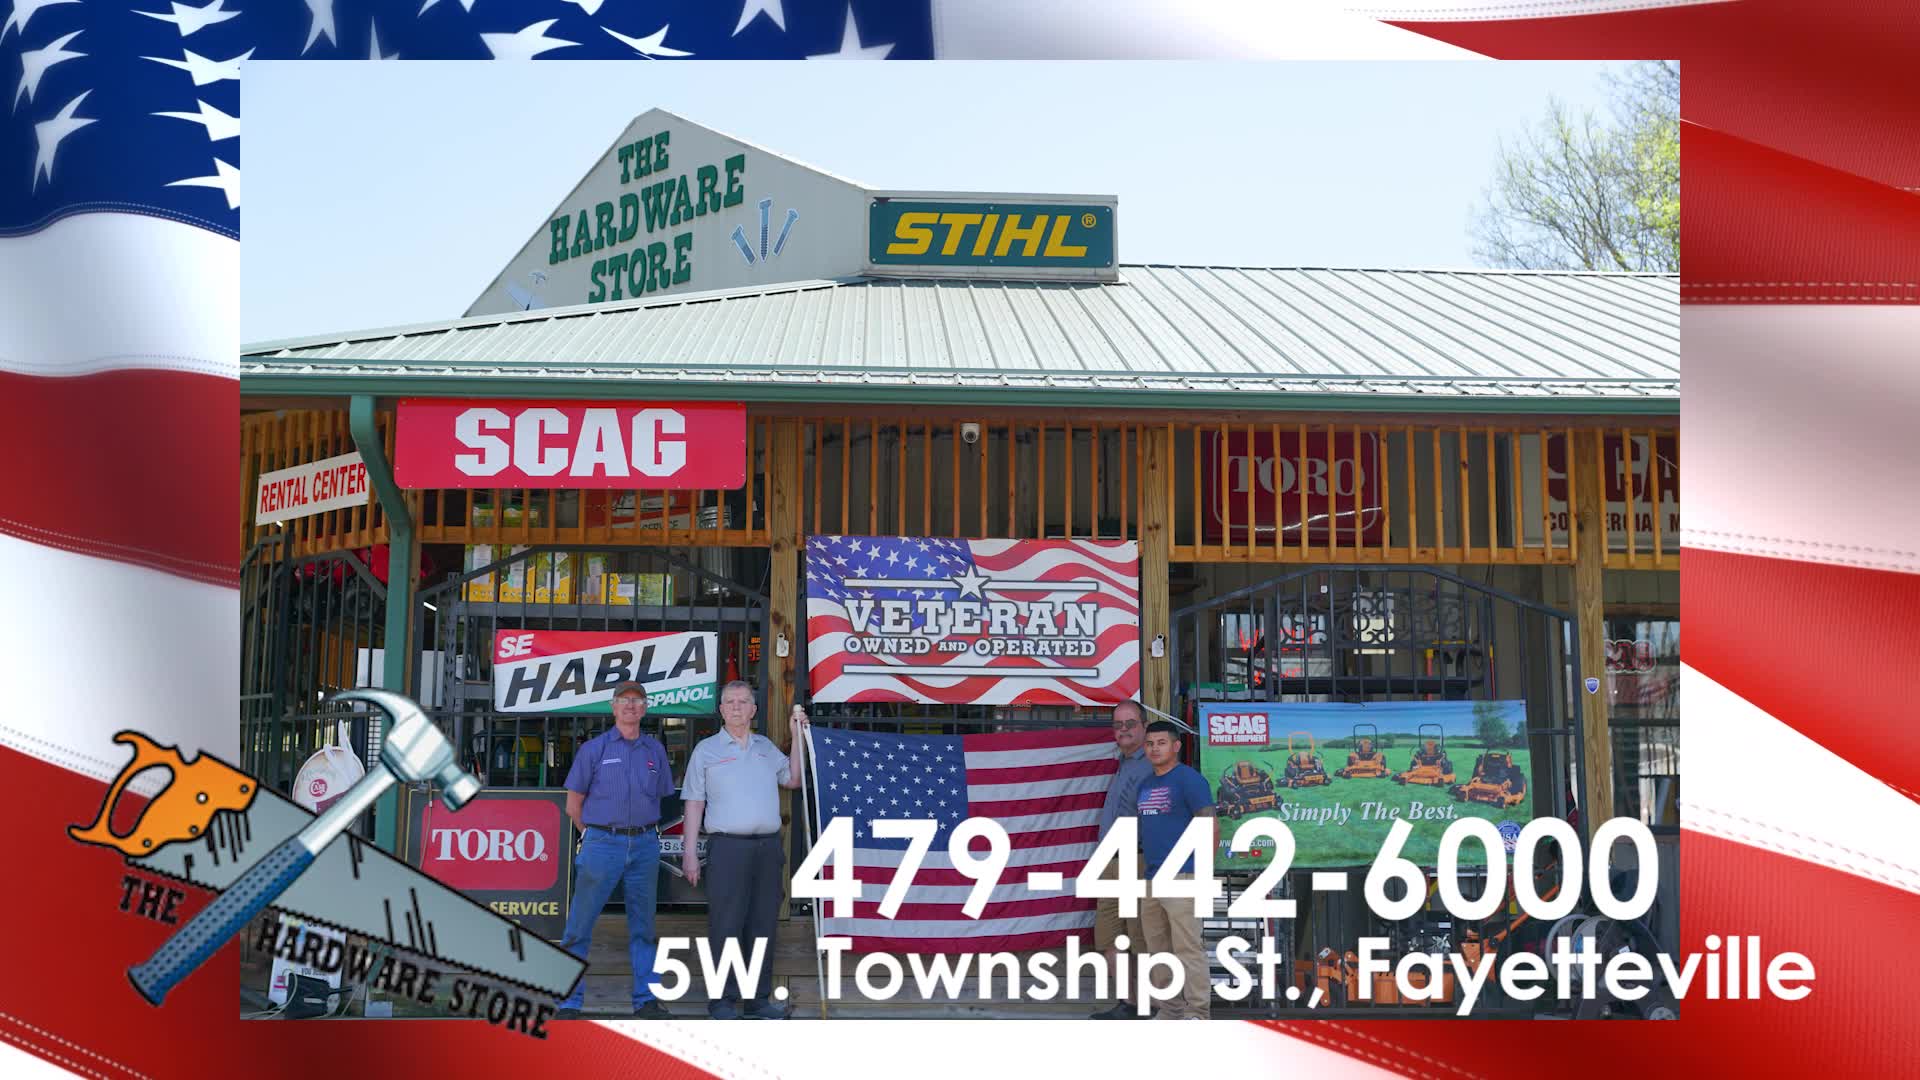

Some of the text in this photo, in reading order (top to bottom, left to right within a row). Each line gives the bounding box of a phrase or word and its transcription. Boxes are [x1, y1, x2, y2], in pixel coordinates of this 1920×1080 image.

[618, 131, 670, 184] THE
[549, 154, 745, 266] HARDWARE
[887, 213, 1087, 257] STIHL
[588, 232, 693, 304] STORE
[455, 408, 687, 477] SCAG
[260, 462, 366, 514] RENTAL CENTER
[1228, 456, 1366, 496] TORO
[843, 599, 1097, 636] VETERAN
[499, 634, 534, 658] SE
[844, 636, 1096, 657] OWNED AND OPERATED
[503, 635, 707, 708] HABLA
[647, 686, 713, 708] SPAÑOL
[1210, 715, 1266, 735] SCAG
[1211, 735, 1266, 743] POWER EQUIPMENT
[1278, 801, 1458, 826] Simply The Best.
[432, 829, 545, 861] TORO
[490, 902, 559, 915] SERVICE
